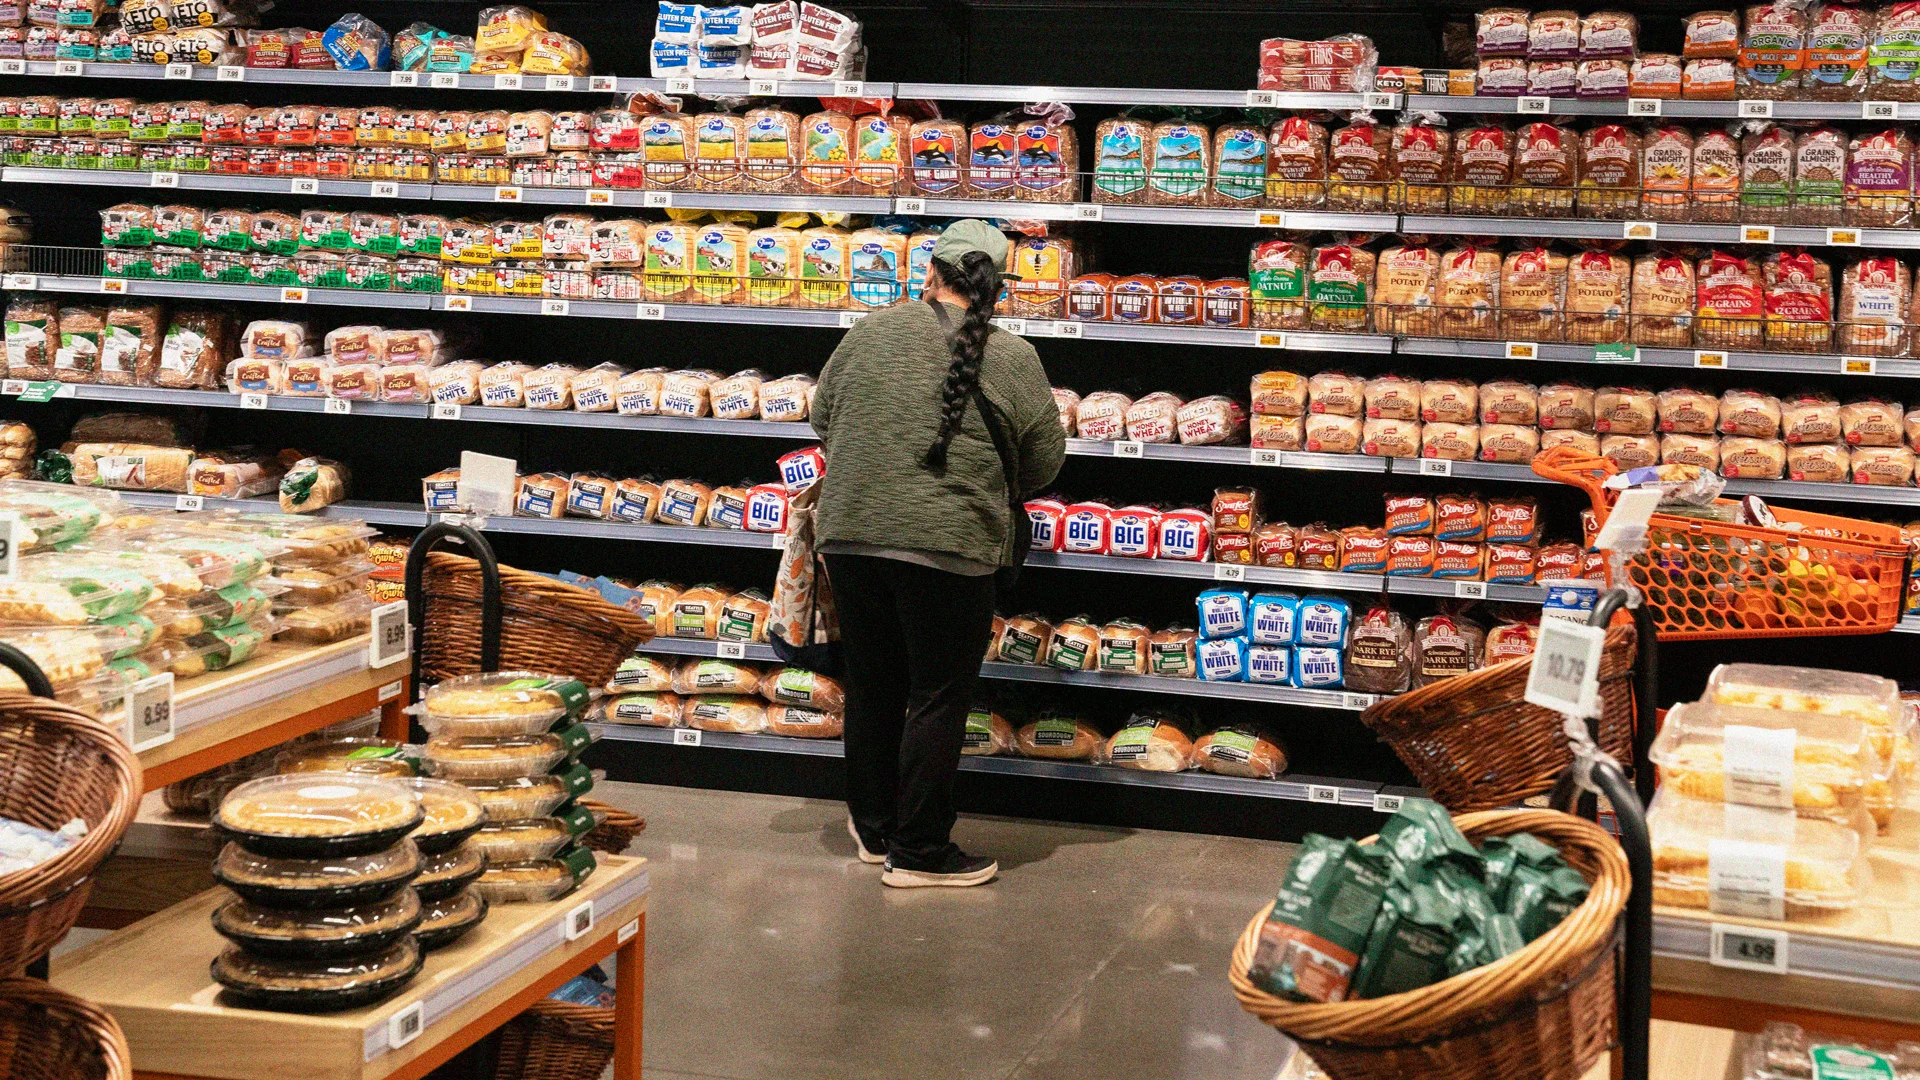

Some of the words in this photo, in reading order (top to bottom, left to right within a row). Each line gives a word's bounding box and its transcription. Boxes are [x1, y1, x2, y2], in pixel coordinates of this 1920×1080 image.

[172, 3, 208, 16] KETO
[124, 6, 161, 24] KETO
[658, 14, 680, 23] GLUTEN
[680, 15, 695, 24] FREE
[800, 12, 824, 26] GLUTEN
[132, 40, 165, 52] KETO
[1751, 38, 1794, 47] ORGANIC
[1816, 38, 1858, 47] ORGANIC
[675, 49, 690, 57] FREE
[1309, 48, 1332, 64] THINS
[1377, 79, 1403, 87] KETO
[1426, 78, 1447, 92] THINS
[1653, 149, 1682, 157] GRAINS
[1647, 156, 1688, 164] ALMIGHTY
[1747, 156, 1787, 164] ALMIGHTY
[321, 237, 331, 246] 21
[369, 242, 379, 250] 21
[567, 244, 585, 252] RIGHT
[462, 250, 474, 258] GOOD
[613, 251, 633, 260] RIGHT
[750, 278, 786, 288] BUTTERMILK
[803, 281, 841, 291] BUTTERMILK
[1257, 282, 1292, 291] OATNUT
[1316, 293, 1354, 302] OATNUT
[1512, 289, 1547, 297] POTATO
[1578, 288, 1613, 297] POTATO
[1651, 293, 1685, 304] POTATO
[1208, 300, 1238, 309] WHOLE
[1715, 300, 1751, 308] GRAINS
[1858, 302, 1894, 310] WHITE
[1775, 307, 1783, 315] 12
[1784, 307, 1821, 315] GRAINS
[257, 339, 281, 347] Crafted
[340, 341, 364, 351] Crafted
[392, 345, 415, 353] Crafted
[242, 372, 265, 380] Crafted
[488, 384, 510, 393] CLASSIC
[531, 386, 554, 395] CLASSIC
[580, 388, 602, 398] CLASSIC
[485, 390, 516, 401] WHITE
[529, 392, 559, 403] WHITE
[578, 394, 608, 407] WHITE
[623, 394, 645, 403] CLASSIC
[621, 399, 651, 410] WHITE
[665, 399, 694, 413] WHITE
[1491, 400, 1529, 411] Artesano
[1080, 405, 1113, 419] NAKED
[1126, 406, 1161, 422] NAKED
[1177, 405, 1210, 422] NAKED
[1088, 420, 1110, 429] HONEY
[1136, 420, 1158, 431] HONEY
[1187, 419, 1210, 430] HONEY
[1792, 422, 1832, 432] Artesano
[1853, 421, 1896, 432] Artesano
[1084, 424, 1117, 436] WHEAT
[1132, 426, 1165, 438] WHEAT
[1184, 423, 1216, 437] WHEAT
[1124, 446, 1138, 454] 4.99
[1262, 454, 1276, 462] 5.29
[1730, 454, 1772, 465] Artesano
[1432, 464, 1446, 472] 5.29
[1795, 459, 1837, 470] Artesano
[785, 461, 815, 484] BIG
[725, 497, 744, 507] SEATTLE
[752, 503, 779, 521] BIG
[1392, 510, 1418, 520] HONEY
[1033, 523, 1051, 541] IG
[1069, 521, 1098, 540] BIG
[1114, 526, 1144, 545] BIG
[1164, 531, 1194, 549] BIG
[375, 554, 394, 565] Own
[1226, 569, 1239, 577] 4.79
[1467, 586, 1481, 594] 5.29
[386, 623, 406, 645] 8.99
[1354, 647, 1376, 656] DARK
[1378, 648, 1396, 656] RYE
[144, 700, 170, 726] 8.99
[684, 734, 696, 742] 6.29
[1037, 732, 1074, 740] SOURDOUGH
[1113, 745, 1146, 754] SOURDOUGH
[1319, 791, 1334, 799] 6.29
[1740, 942, 1775, 959] 4.99
